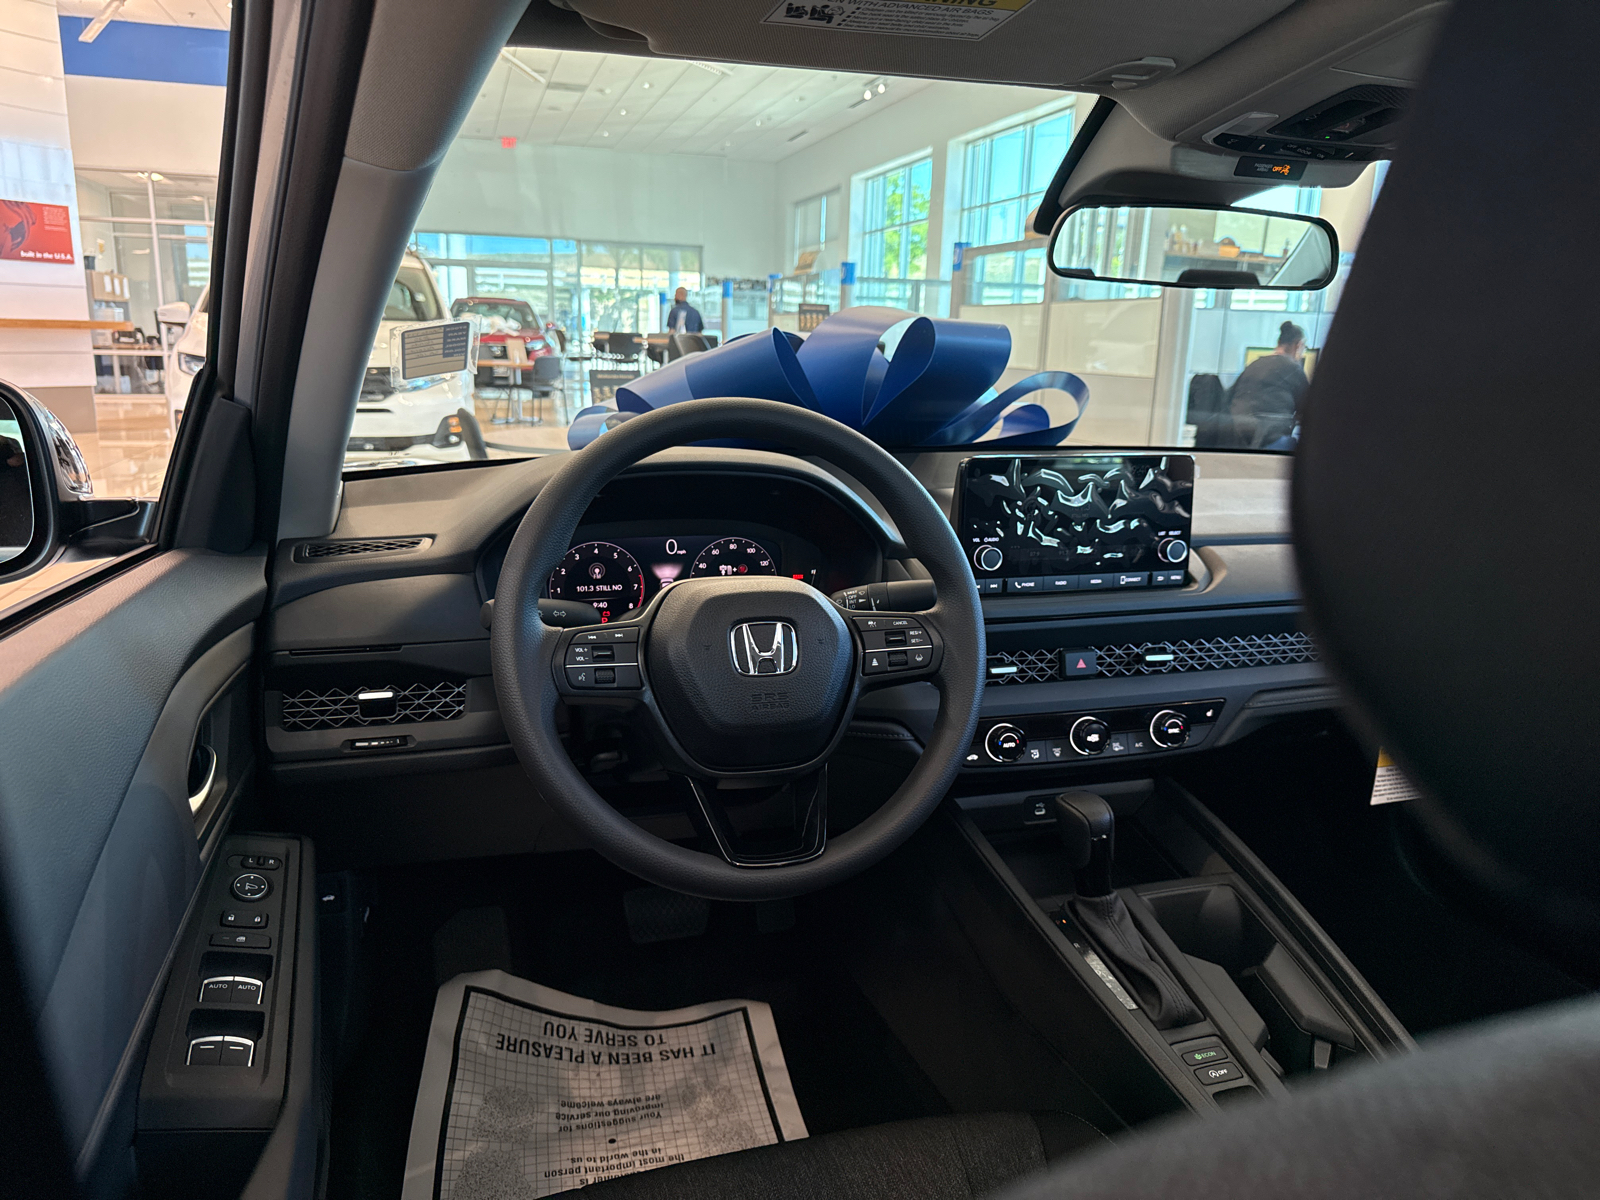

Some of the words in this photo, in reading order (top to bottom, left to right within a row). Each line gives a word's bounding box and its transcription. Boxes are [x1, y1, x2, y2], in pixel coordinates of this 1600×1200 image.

[880, 2, 941, 11] ADVANCED
[962, 8, 994, 16] BAGS
[595, 584, 612, 592] STILL
[592, 601, 608, 609] 9:40
[543, 1021, 578, 1042] YOU
[584, 1028, 638, 1047] SERVE
[644, 1033, 667, 1046] TO
[496, 1033, 585, 1064] PLEASURE
[701, 1043, 717, 1057] IT
[592, 1051, 601, 1065] A
[608, 1050, 653, 1065] BEEN
[660, 1047, 695, 1062] HAS
[1201, 1051, 1217, 1059] ECON
[1217, 1068, 1228, 1076] OFF
[607, 1096, 642, 1107] always
[594, 1110, 611, 1118] our
[614, 1102, 664, 1117] improving
[555, 1112, 591, 1121] service
[640, 1111, 662, 1120] Your
[558, 1124, 572, 1133] for
[576, 1116, 636, 1131] suggestions
[632, 1149, 648, 1157] the
[651, 1147, 661, 1155] in
[600, 1152, 629, 1164] world
[639, 1157, 665, 1166] most
[669, 1153, 685, 1162] the
[544, 1165, 582, 1178] person
[584, 1160, 636, 1174] important
[579, 1178, 589, 1186] is
